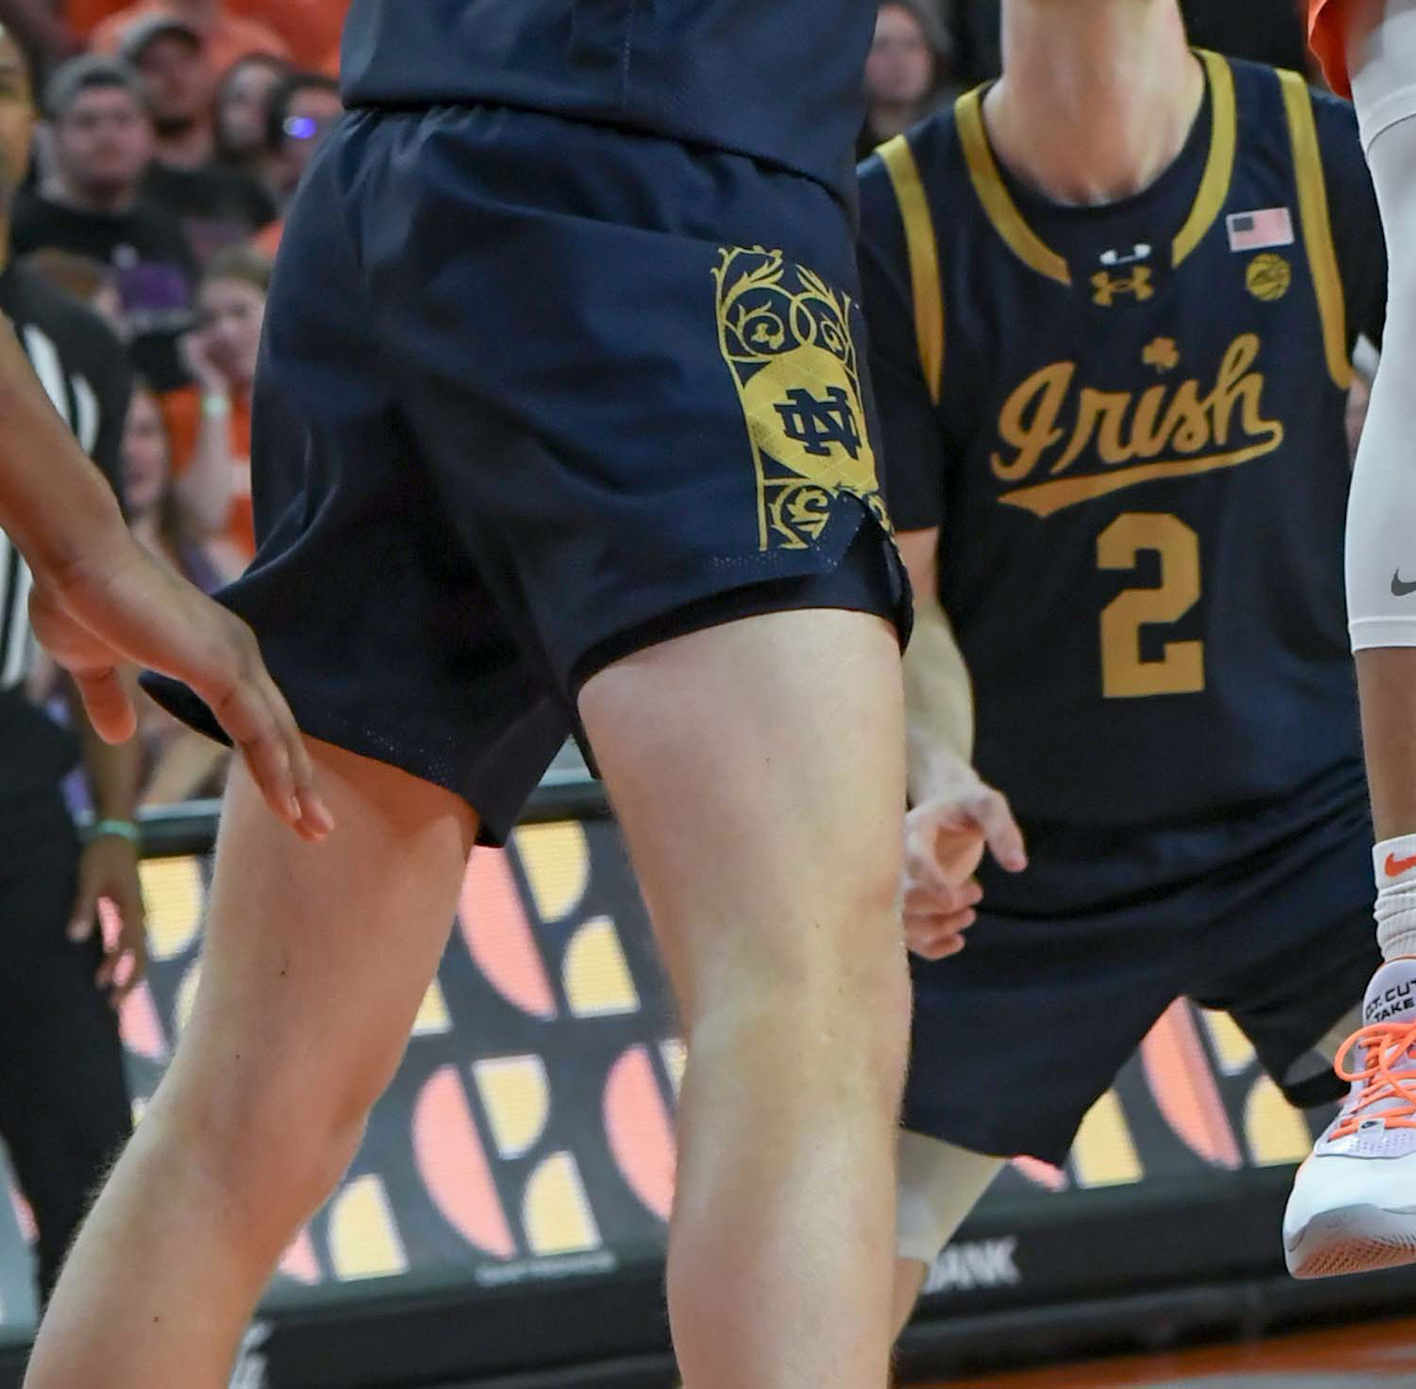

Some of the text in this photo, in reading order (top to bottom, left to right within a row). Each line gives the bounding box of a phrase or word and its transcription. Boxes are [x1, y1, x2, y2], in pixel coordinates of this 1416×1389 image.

[990, 333, 1284, 513] Irish
[1097, 512, 1205, 698] 2
[1374, 998, 1415, 1022] TAKE
